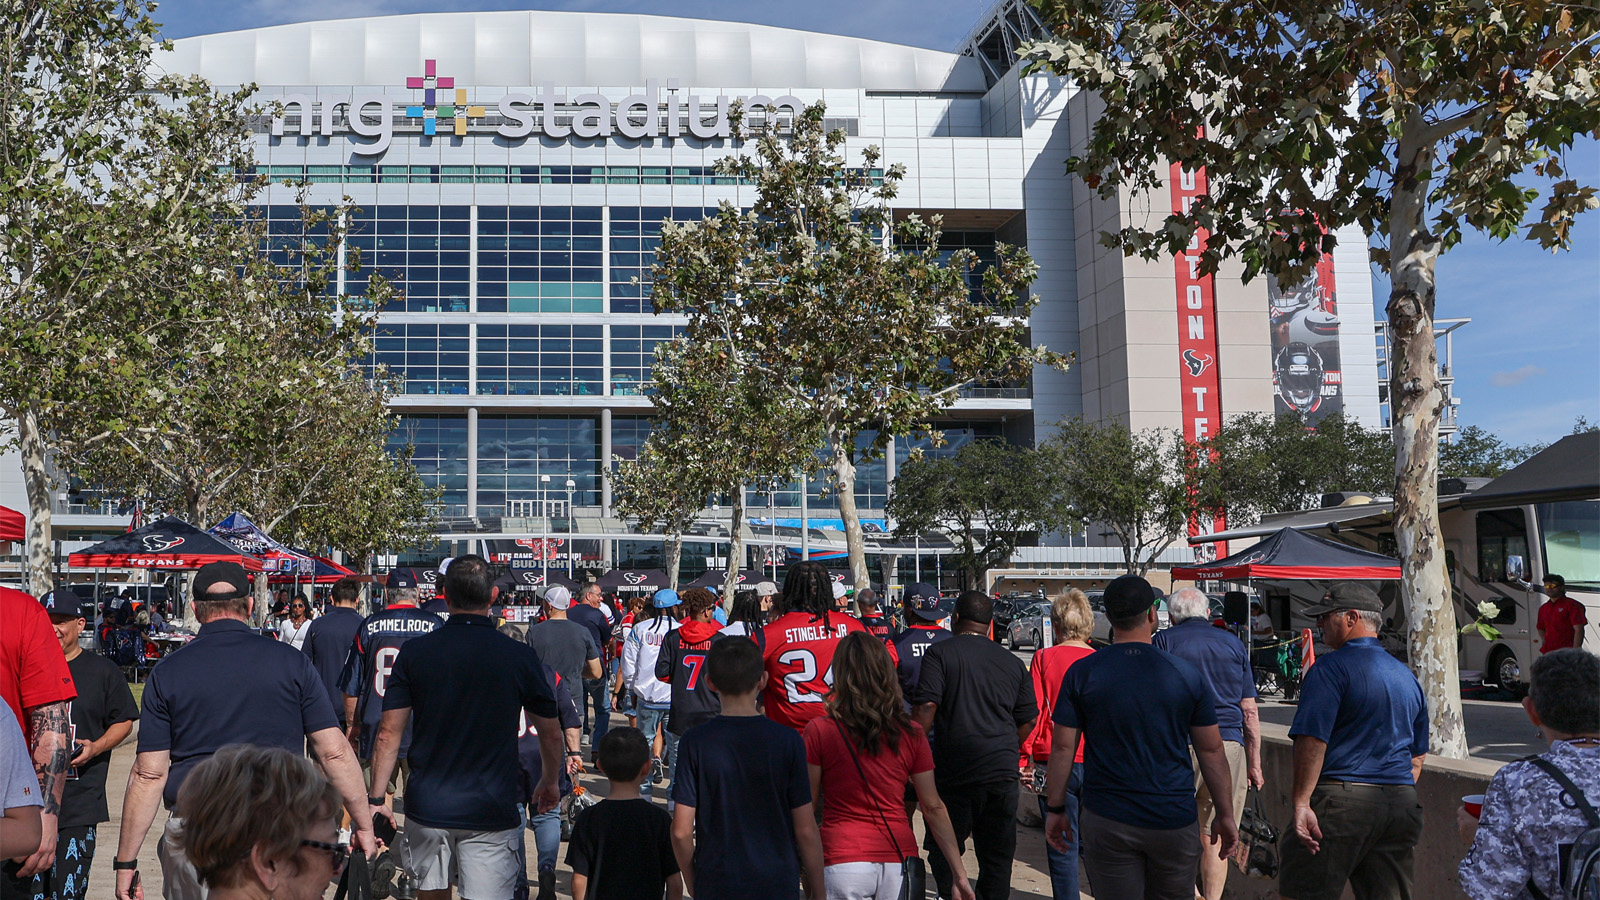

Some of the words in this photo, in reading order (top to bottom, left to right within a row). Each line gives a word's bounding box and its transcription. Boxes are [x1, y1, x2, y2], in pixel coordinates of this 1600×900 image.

[271, 93, 393, 155] nrg
[497, 78, 806, 139] stadium
[126, 558, 185, 566] TEXANS
[512, 559, 537, 569] BUD
[538, 559, 570, 569] LGHT
[575, 560, 612, 569] PLAZA
[1197, 571, 1224, 579] TEXANS
[367, 619, 435, 636] SEMMELROCK
[835, 623, 848, 638] JR
[682, 654, 707, 691] 7
[778, 648, 834, 703] 2
